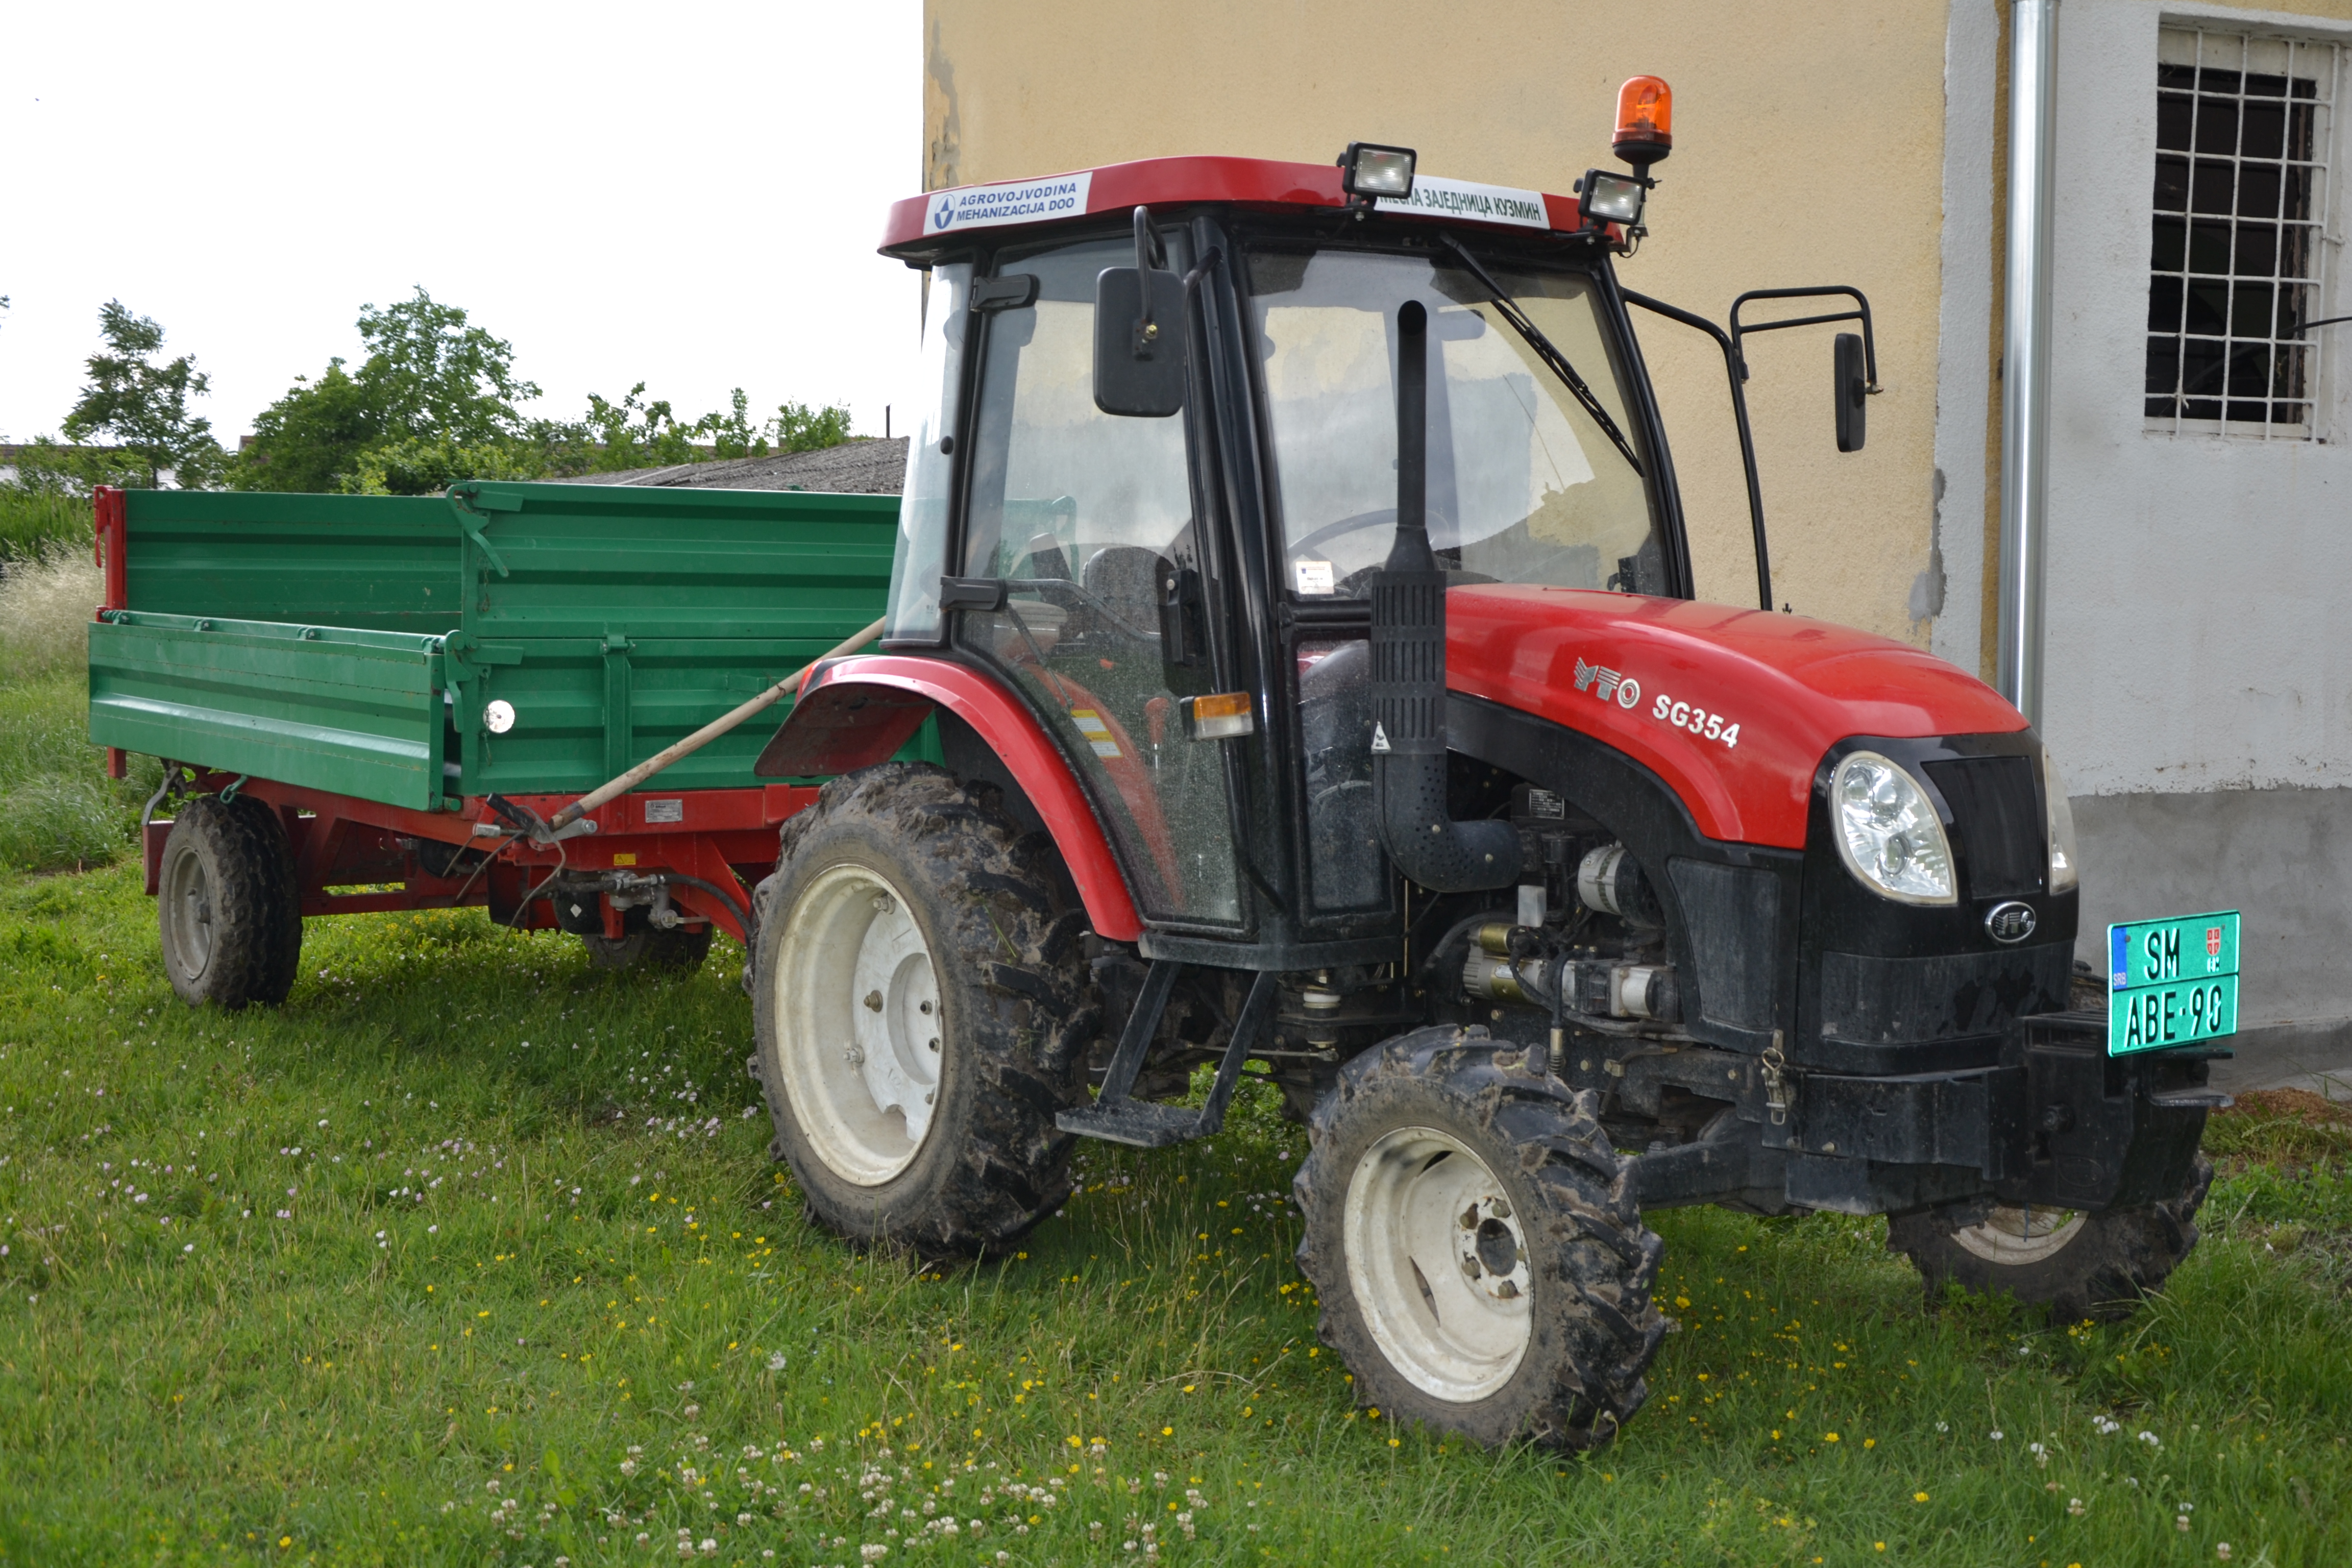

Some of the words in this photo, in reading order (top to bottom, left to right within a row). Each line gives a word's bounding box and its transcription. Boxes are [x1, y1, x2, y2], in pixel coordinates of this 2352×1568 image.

[957, 202, 1045, 222] MEHANIZACIJA
[1048, 197, 1075, 211] DOO
[959, 183, 1076, 207] AGROVOJVODINA
[1424, 188, 1493, 217] ЗАЈЕДНИЦА
[1493, 197, 1541, 221] КУЗМИН
[1652, 694, 1740, 748] SG354
[2144, 927, 2180, 980] SM
[2113, 972, 2126, 986] SRB
